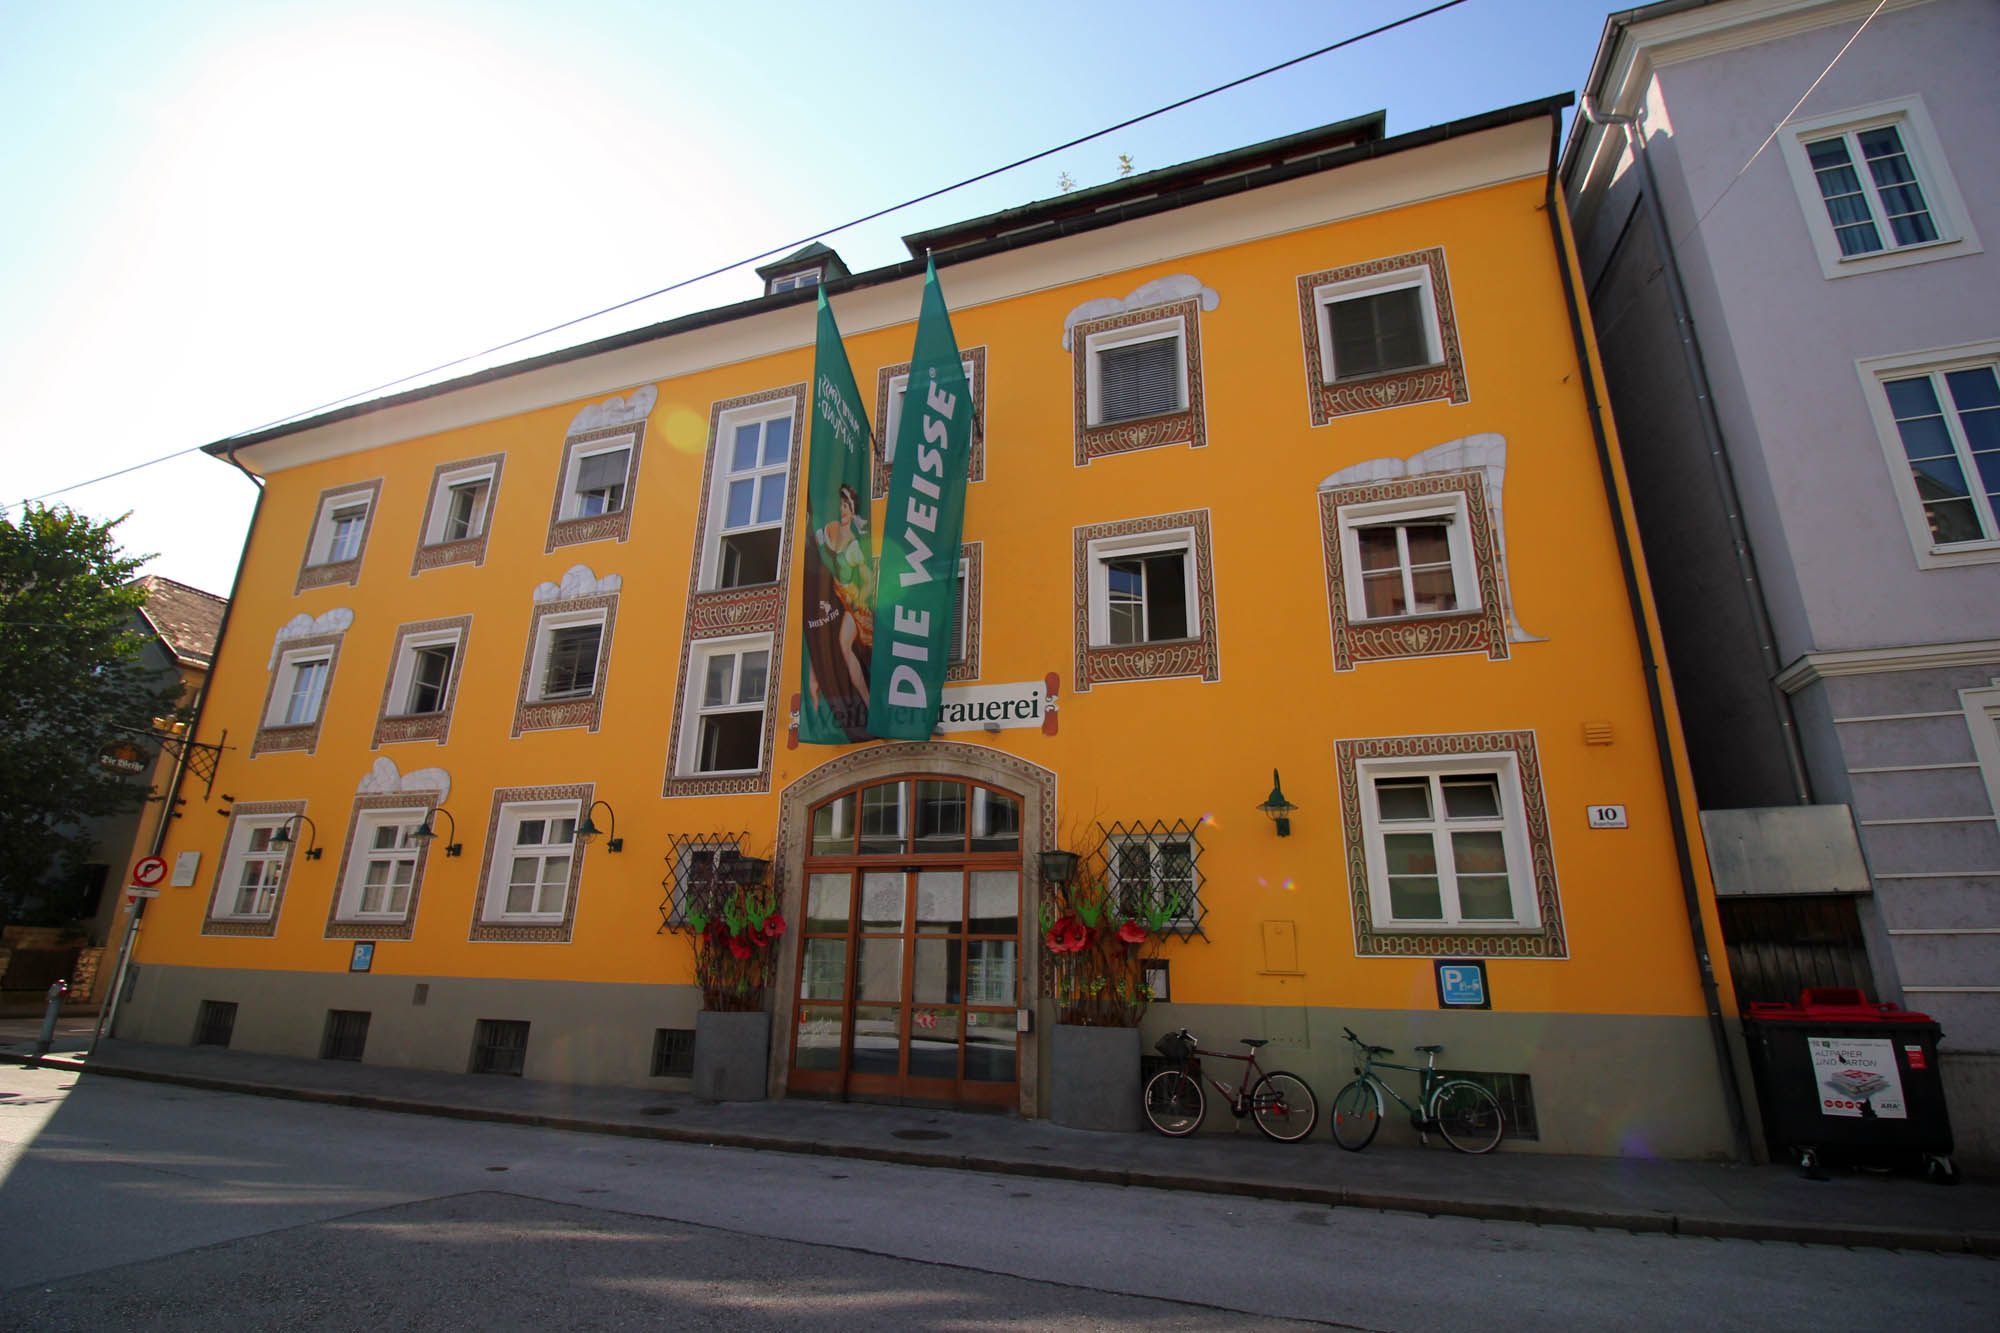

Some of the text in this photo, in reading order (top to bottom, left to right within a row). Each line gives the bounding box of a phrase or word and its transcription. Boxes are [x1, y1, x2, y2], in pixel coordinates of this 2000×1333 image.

[888, 604, 930, 709] DIE
[1597, 808, 1617, 820] 10
[1445, 969, 1462, 991] P
[1815, 1049, 1863, 1058] ALTPAPIER
[1839, 1059, 1877, 1067] ARTON
